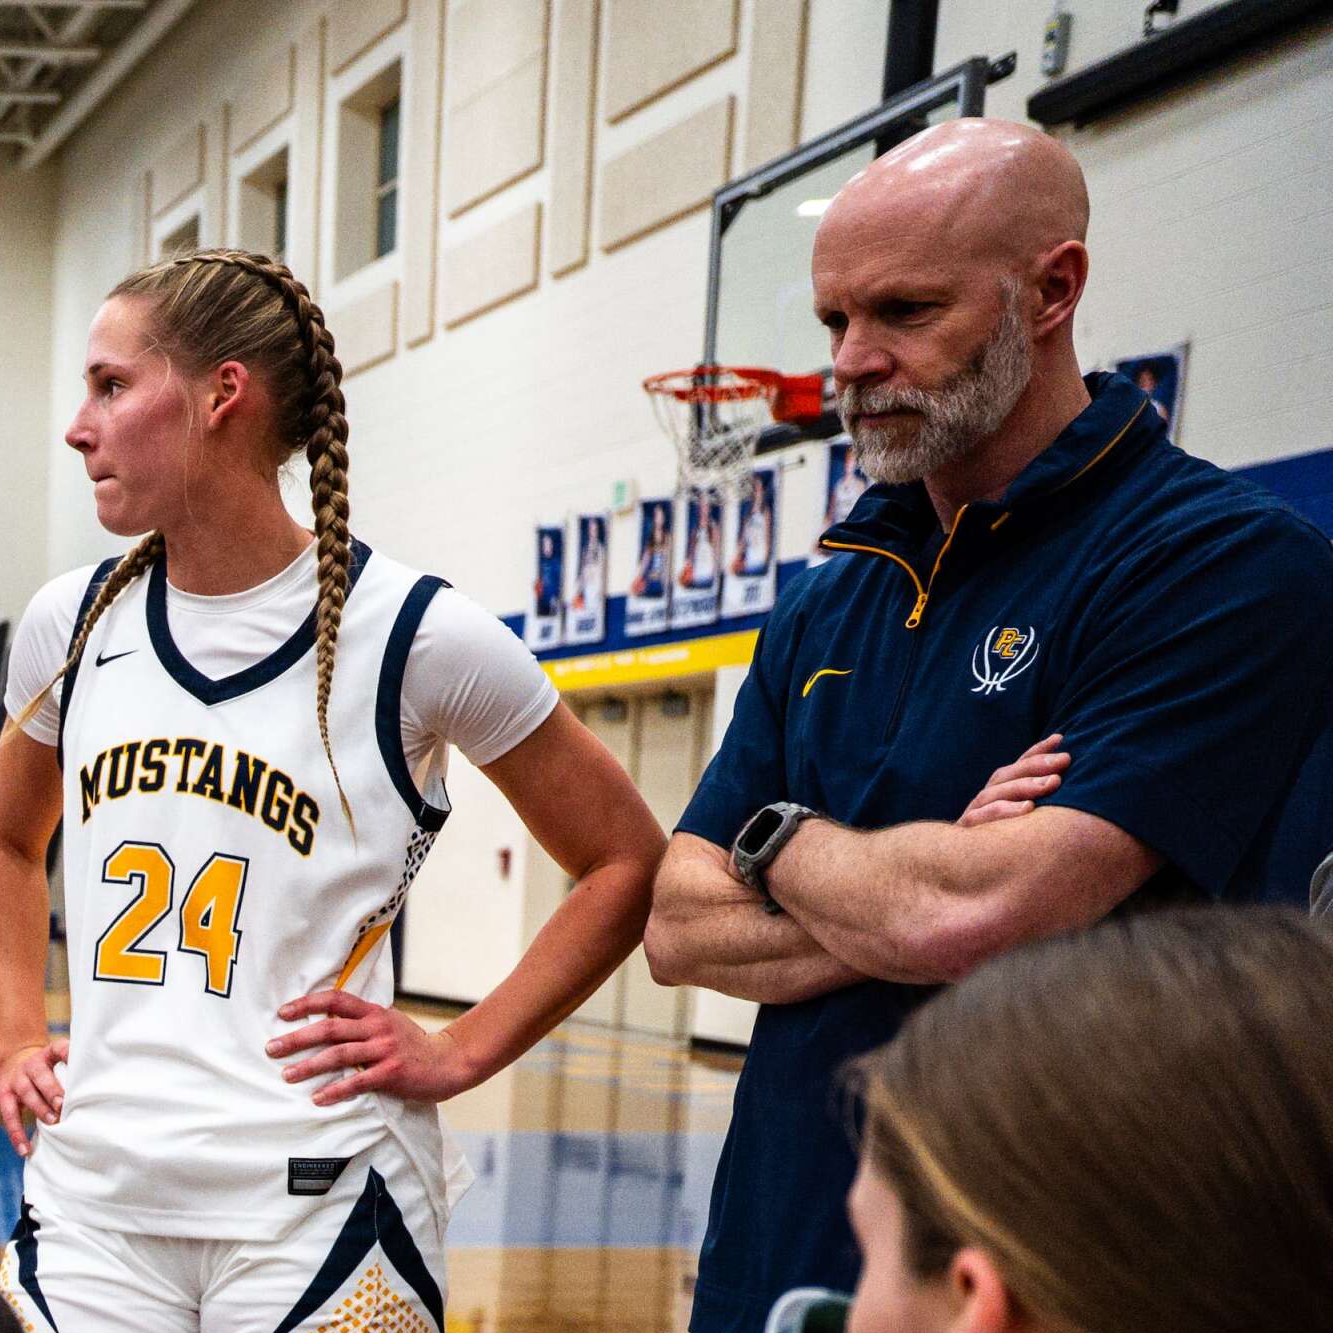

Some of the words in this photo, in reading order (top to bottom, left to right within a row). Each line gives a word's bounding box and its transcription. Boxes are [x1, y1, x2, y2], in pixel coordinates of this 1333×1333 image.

[992, 627, 1027, 660] PC
[79, 737, 321, 858] MUSTANGS
[93, 839, 250, 999] 24
